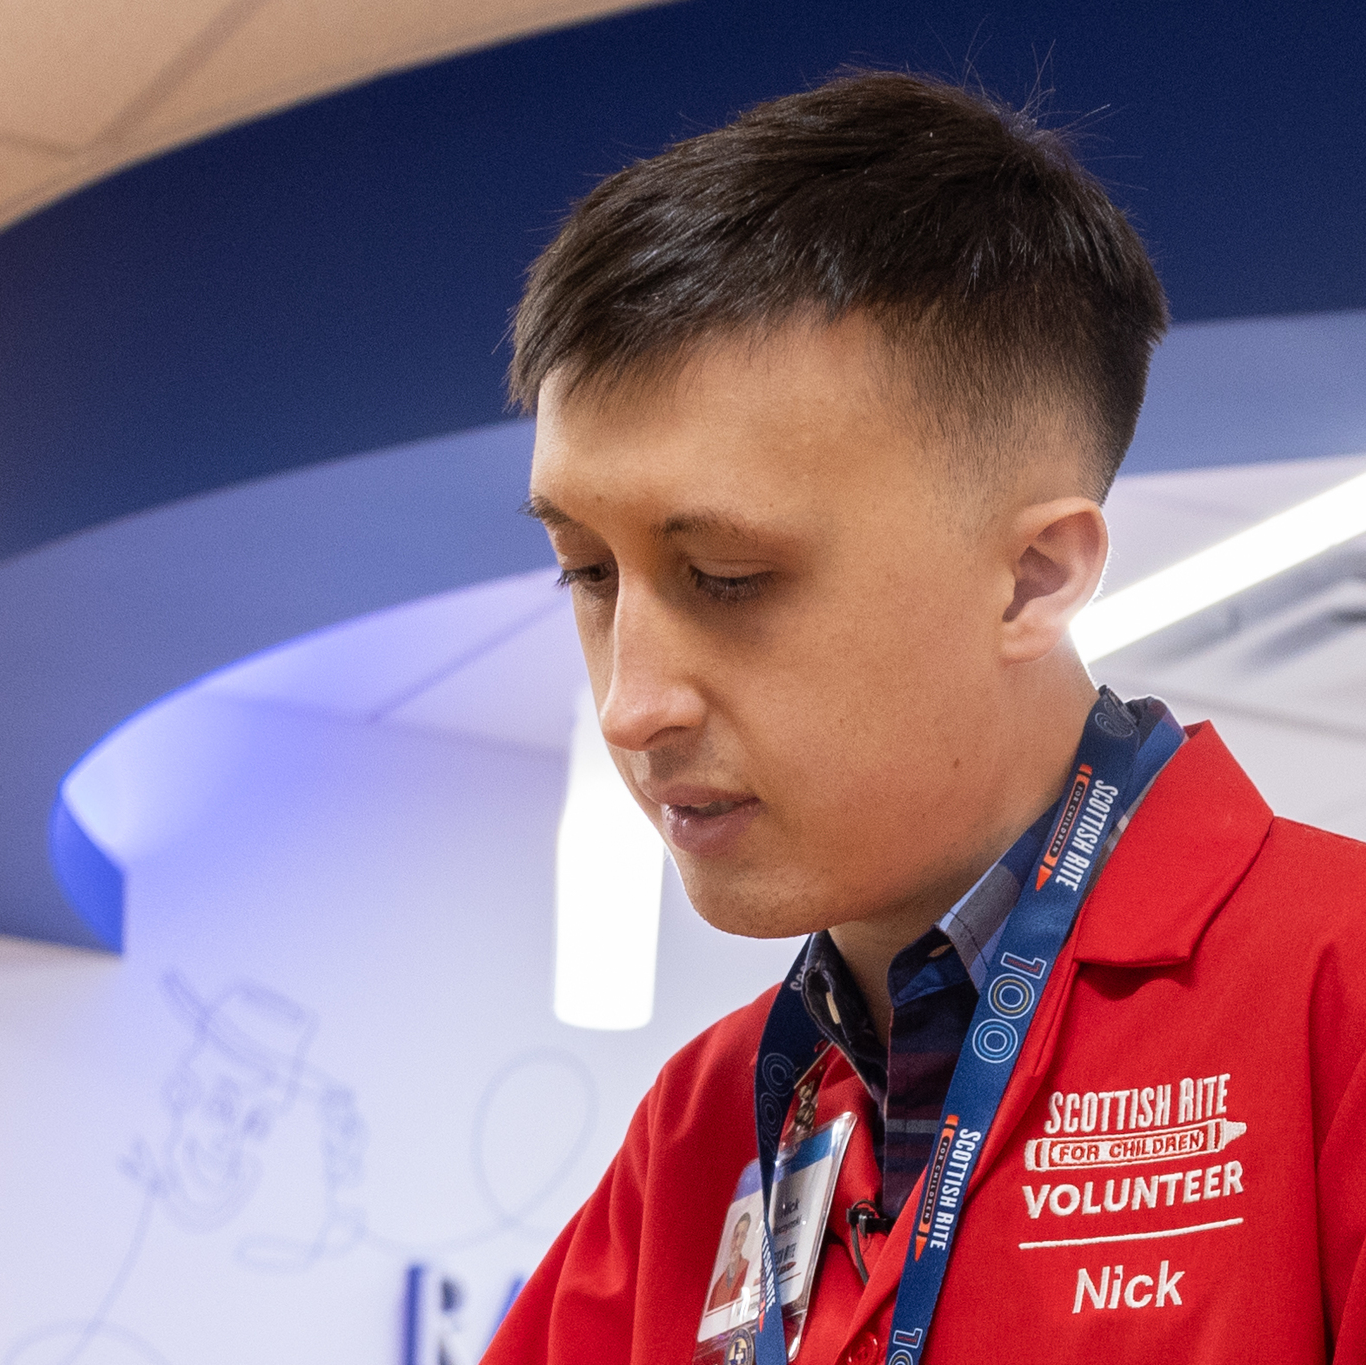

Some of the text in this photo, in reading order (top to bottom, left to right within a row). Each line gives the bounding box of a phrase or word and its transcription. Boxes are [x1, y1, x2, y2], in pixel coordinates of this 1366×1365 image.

[1051, 786, 1084, 854] FOR CHILDREN
[1071, 780, 1119, 860] SCOTTISH
[1055, 853, 1091, 892] RITE
[972, 951, 1047, 1064] 100
[1044, 1073, 1231, 1135] SCOTTISH RITE
[1058, 1130, 1201, 1162] FOR CHILDREN
[924, 1142, 948, 1219] FOR CHILDREN
[930, 1128, 981, 1251] SCOTTISH RITE
[1021, 1160, 1244, 1219] VOLUNTEER
[765, 1272, 777, 1313] RITE
[1072, 1260, 1185, 1314] Nick
